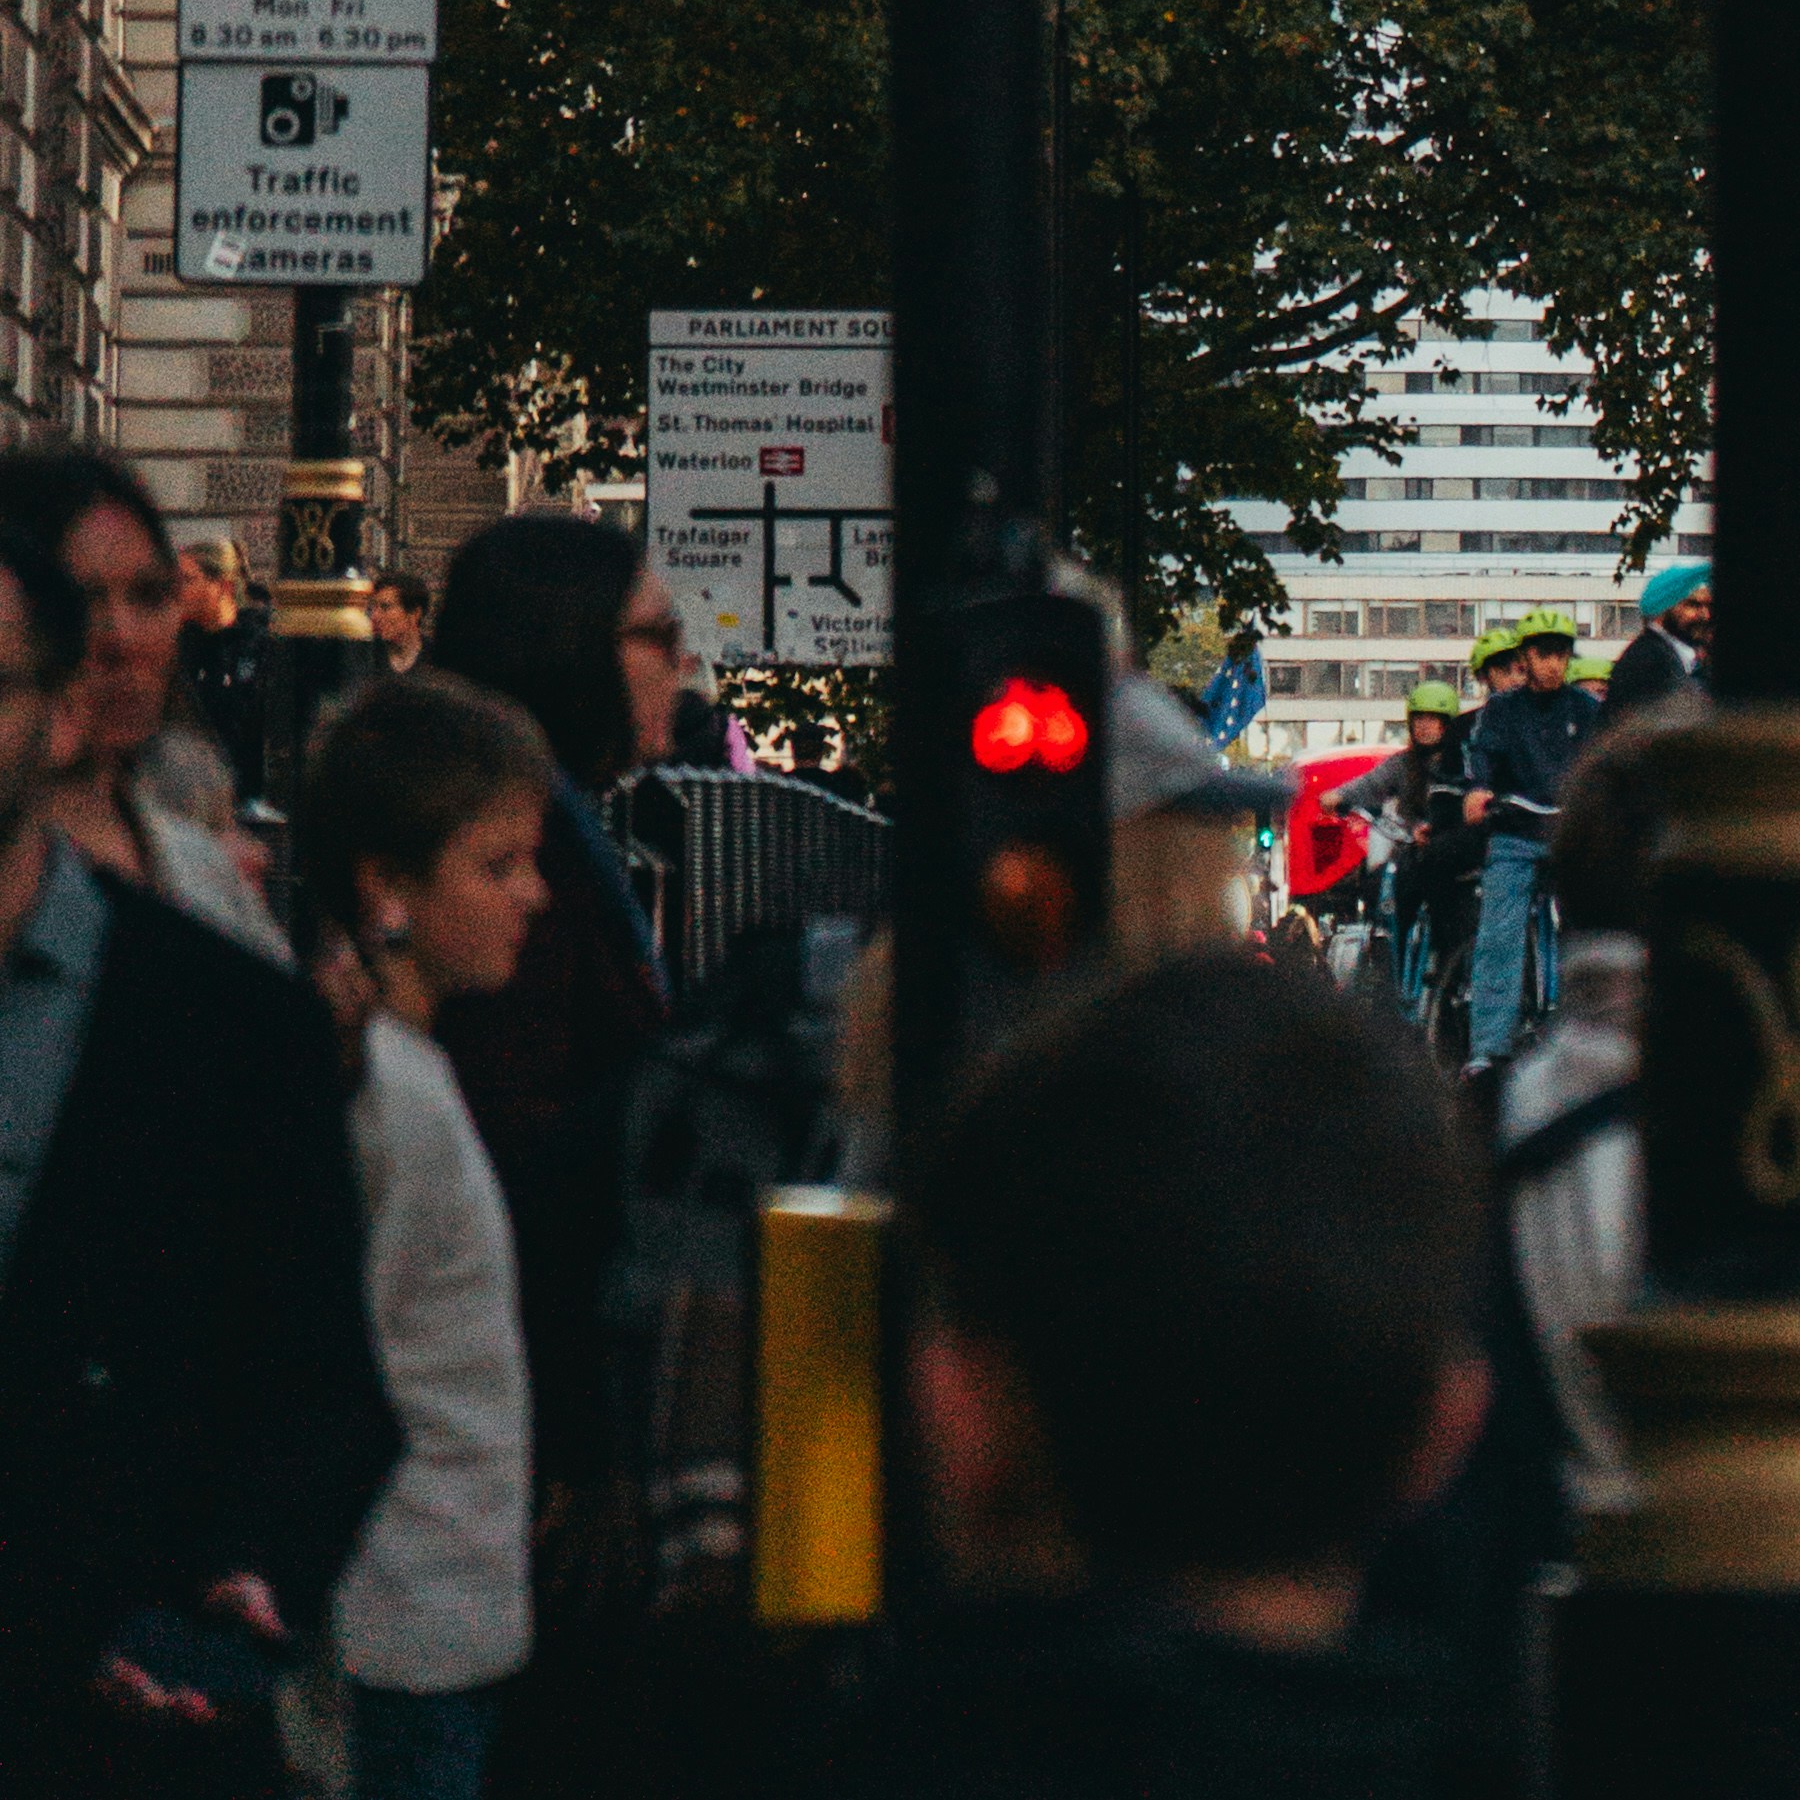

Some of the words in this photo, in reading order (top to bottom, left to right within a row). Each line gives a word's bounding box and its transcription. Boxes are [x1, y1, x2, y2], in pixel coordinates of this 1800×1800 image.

[247, 163, 361, 196] Traffic
[191, 202, 412, 237] enforcement
[236, 247, 373, 272] ameras
[689, 319, 838, 339] PARLIAMENT
[657, 356, 694, 375] The
[702, 356, 745, 377] City
[657, 378, 790, 397] Westminster
[799, 377, 868, 399] Bridge
[786, 413, 875, 435] Hospital
[656, 451, 752, 471] Waterloo
[657, 527, 751, 547] Trafalgar
[667, 549, 742, 569] Square
